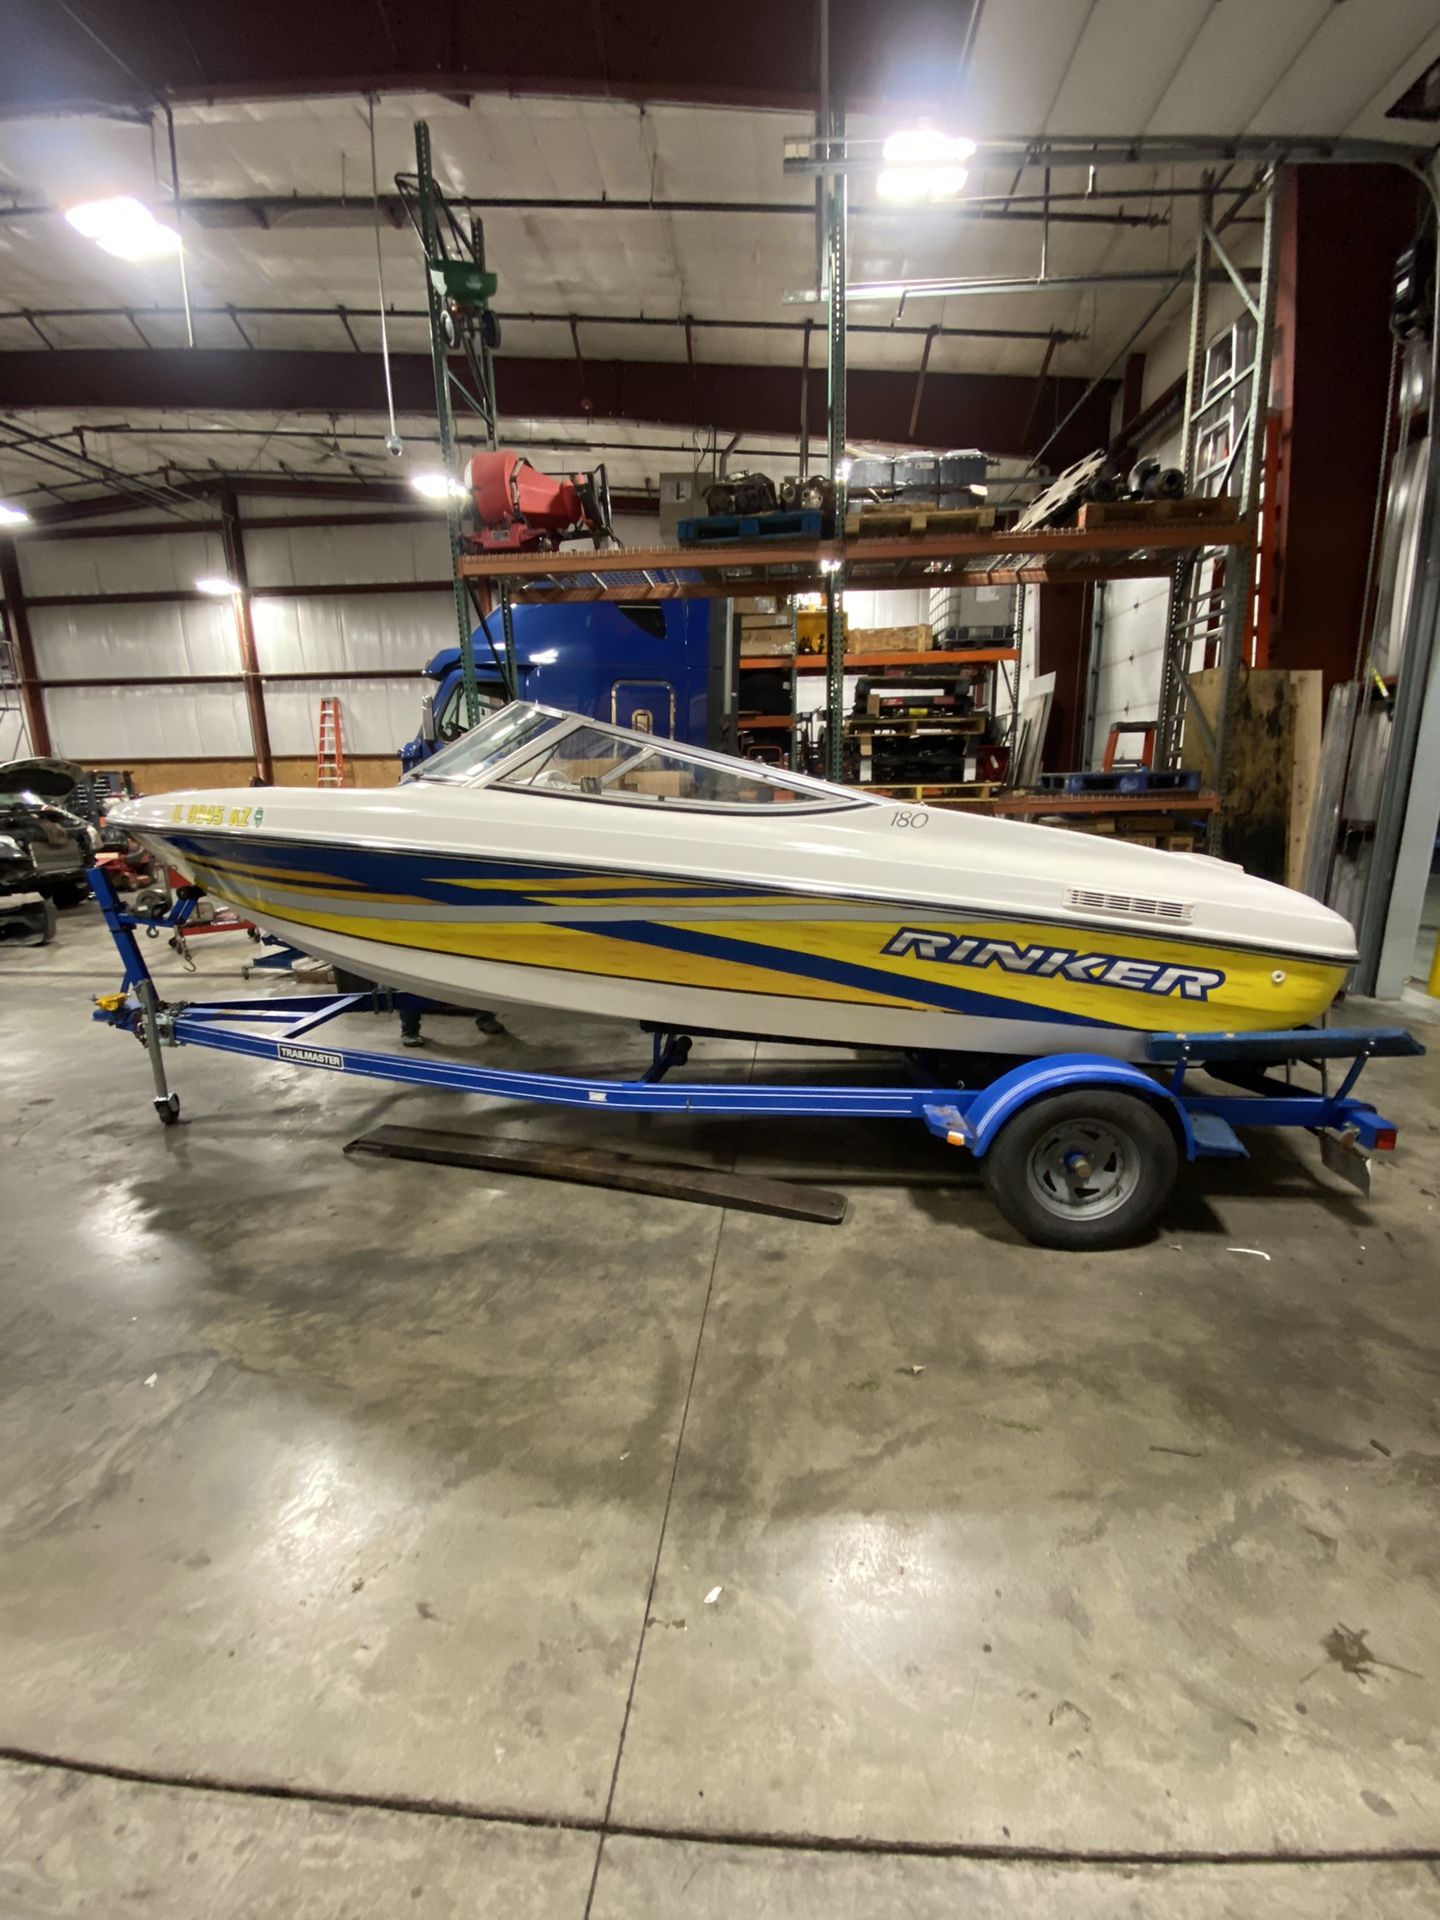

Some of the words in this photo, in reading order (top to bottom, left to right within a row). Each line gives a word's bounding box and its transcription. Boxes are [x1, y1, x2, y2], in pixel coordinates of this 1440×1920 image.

[890, 810, 929, 829] 180
[881, 927, 1226, 1001] RINKER
[280, 1047, 341, 1066] TRAILMASTER
